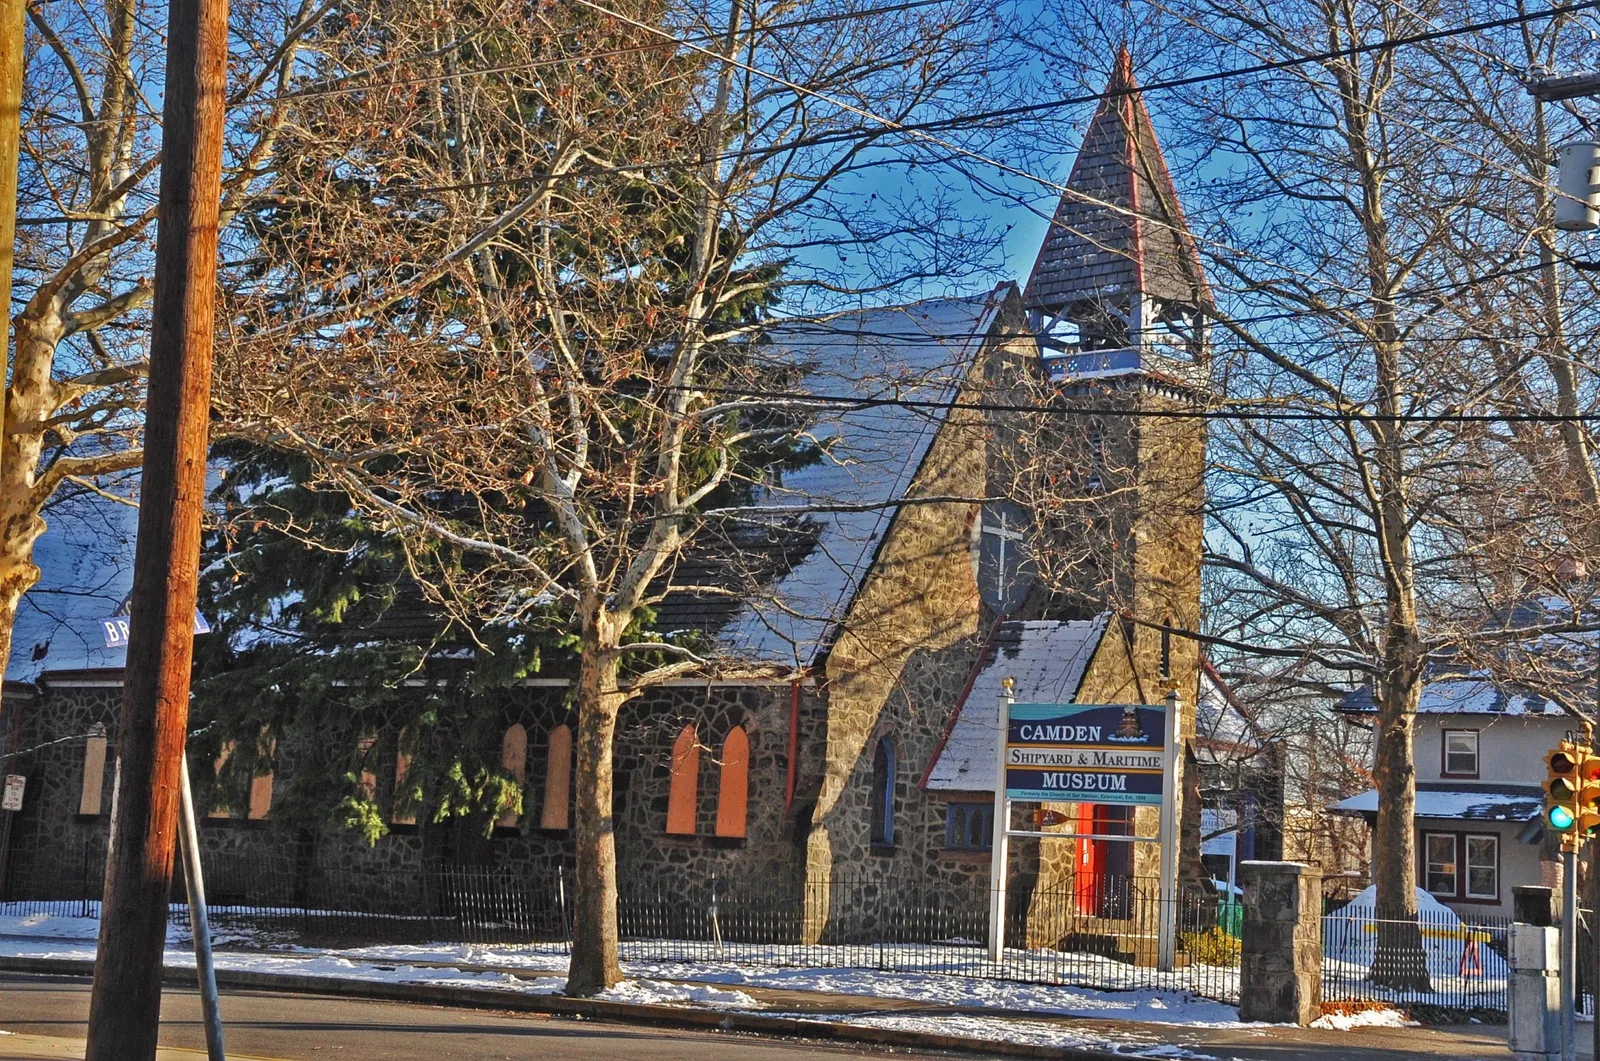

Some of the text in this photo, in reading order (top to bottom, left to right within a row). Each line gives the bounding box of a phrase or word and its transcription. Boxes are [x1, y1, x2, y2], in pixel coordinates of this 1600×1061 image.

[1020, 724, 1102, 742] CAMDEN
[1011, 749, 1161, 767] SHIPYARD & MARITIME
[1042, 772, 1127, 791] MUSEUM
